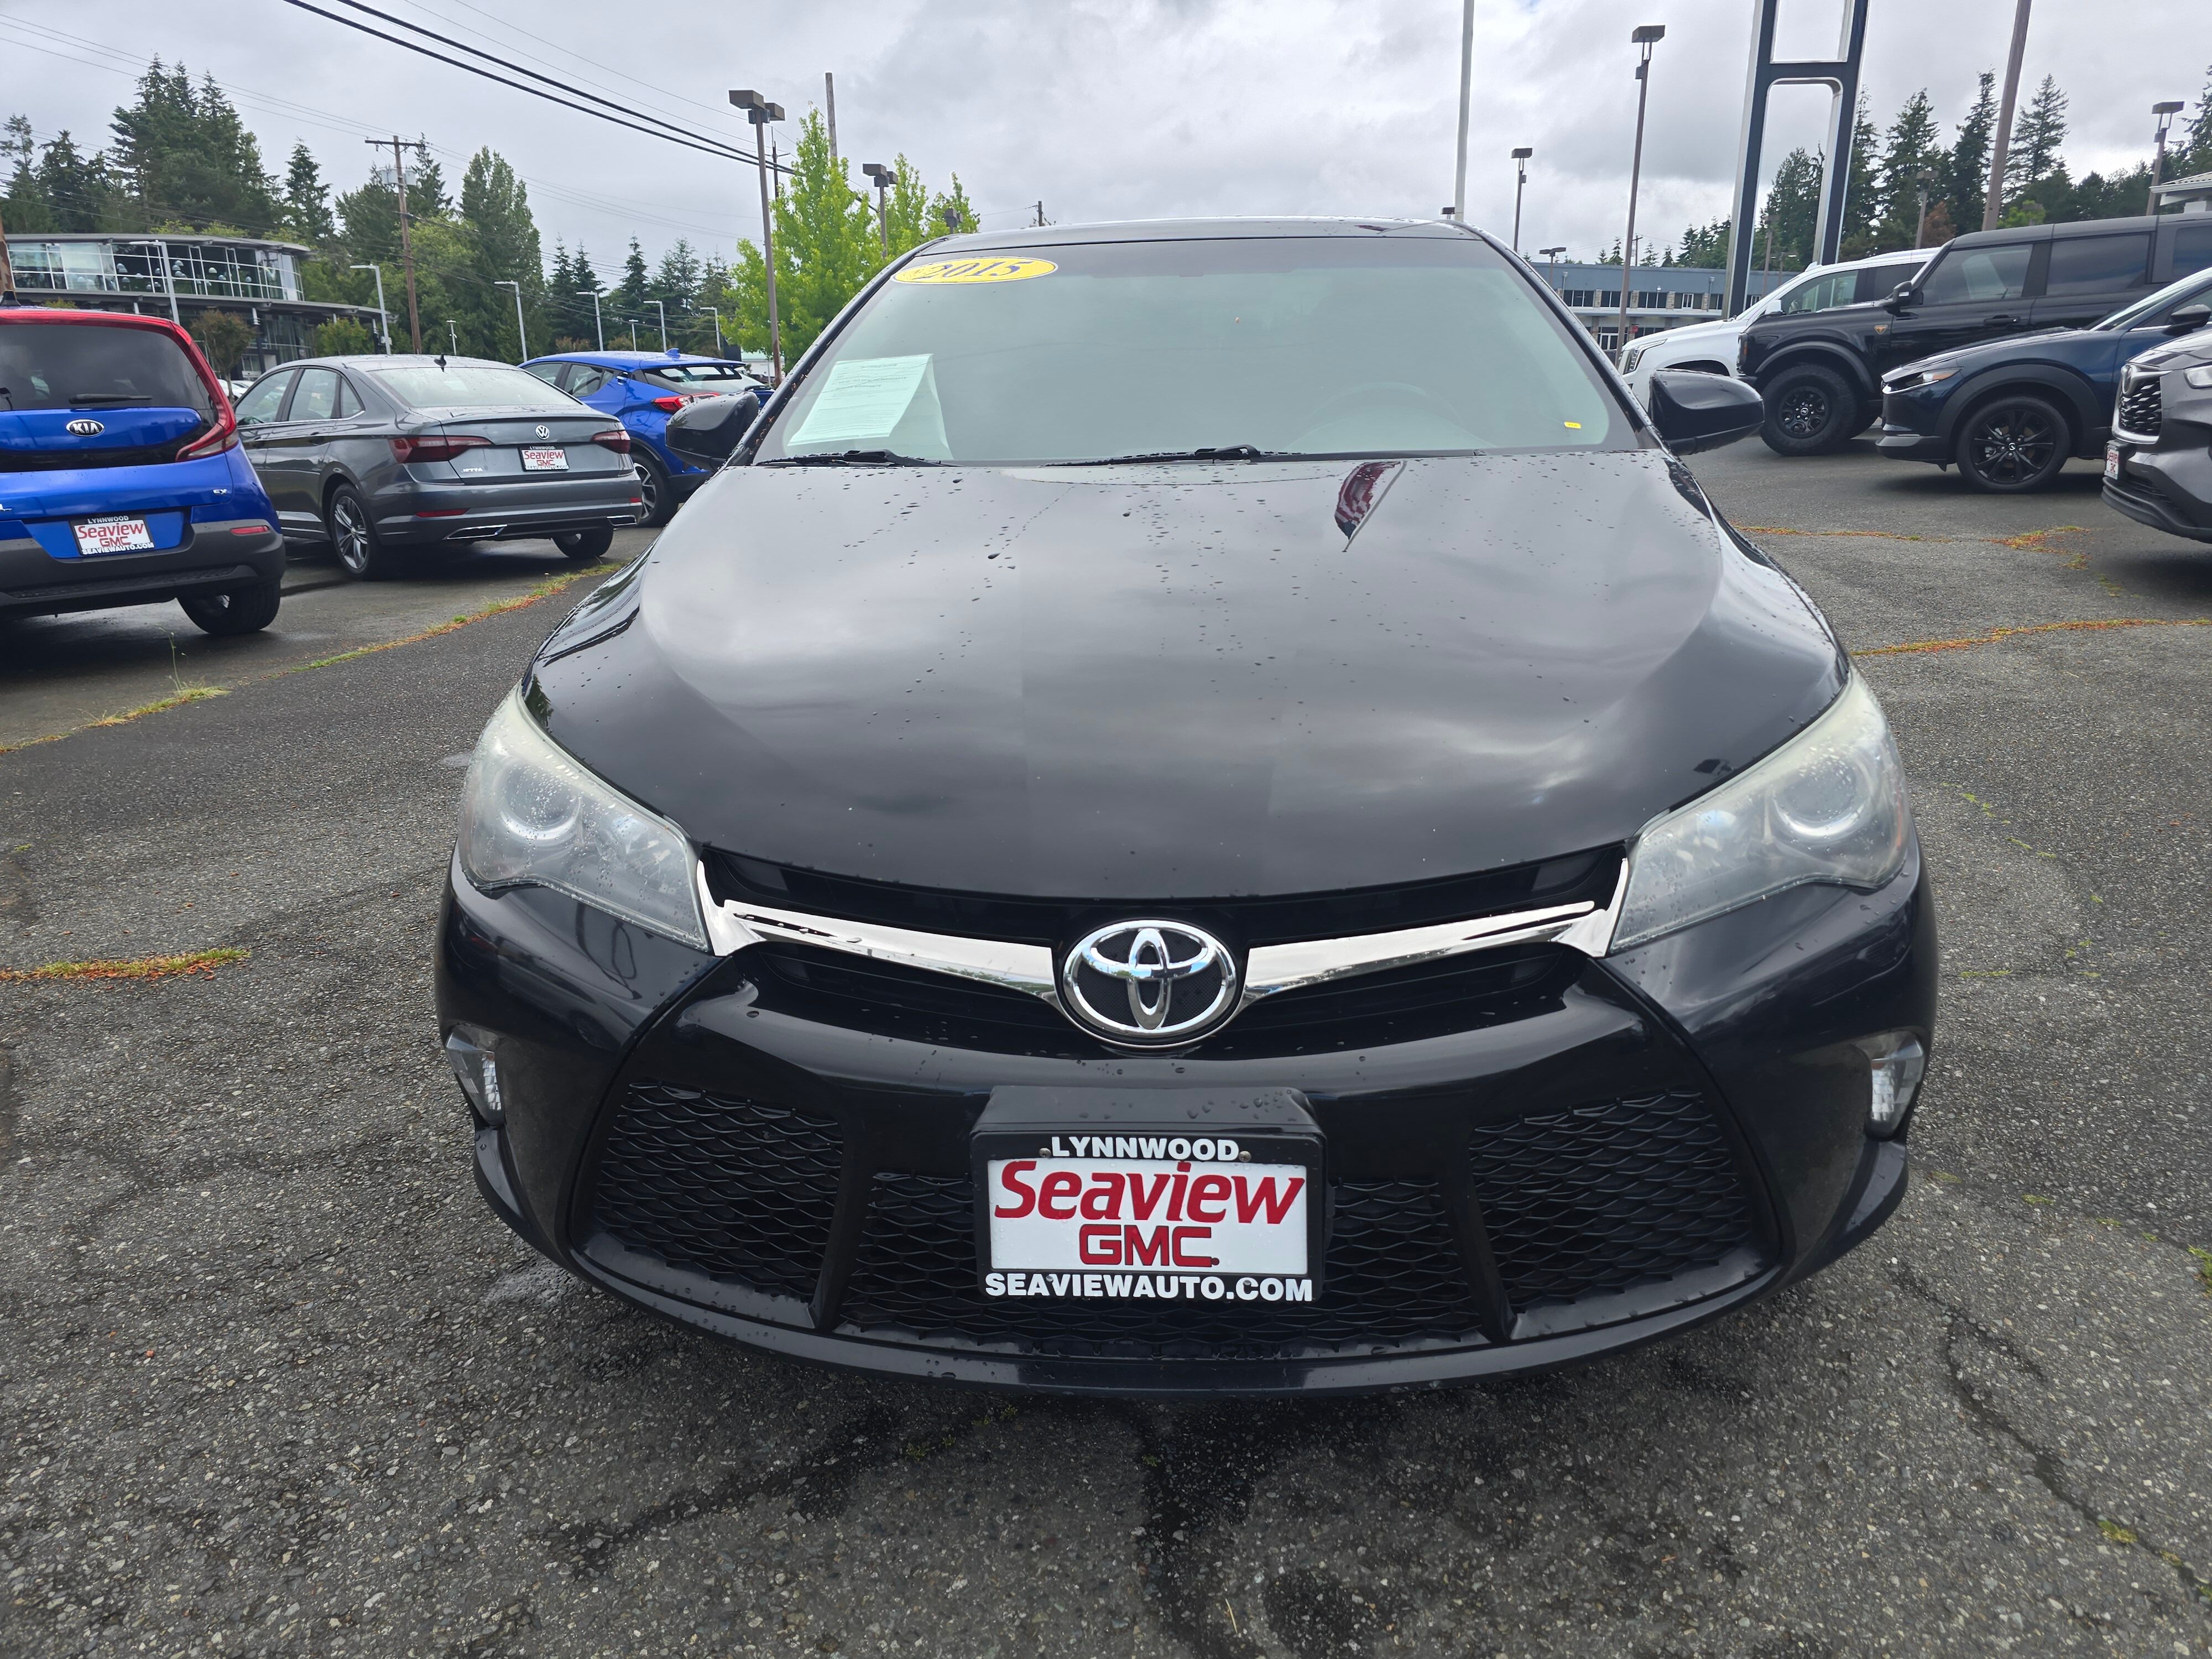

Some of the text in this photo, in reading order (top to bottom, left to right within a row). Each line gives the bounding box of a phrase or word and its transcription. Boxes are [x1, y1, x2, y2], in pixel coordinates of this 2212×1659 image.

[912, 261, 1035, 279] 2015
[72, 422, 100, 434] KIA
[524, 450, 564, 460] Seaview
[87, 515, 129, 524] LYNNWOOD
[78, 523, 144, 539] Seaview
[82, 542, 154, 555] SEAVIEWAUTO.COM
[100, 536, 132, 547] GMC
[1051, 1136, 1239, 1161] LYNNWOOD
[995, 1160, 1306, 1224] Seaview
[1079, 1223, 1215, 1267] GMC
[985, 1273, 1312, 1302] SEAVIEWAUTO.COM
